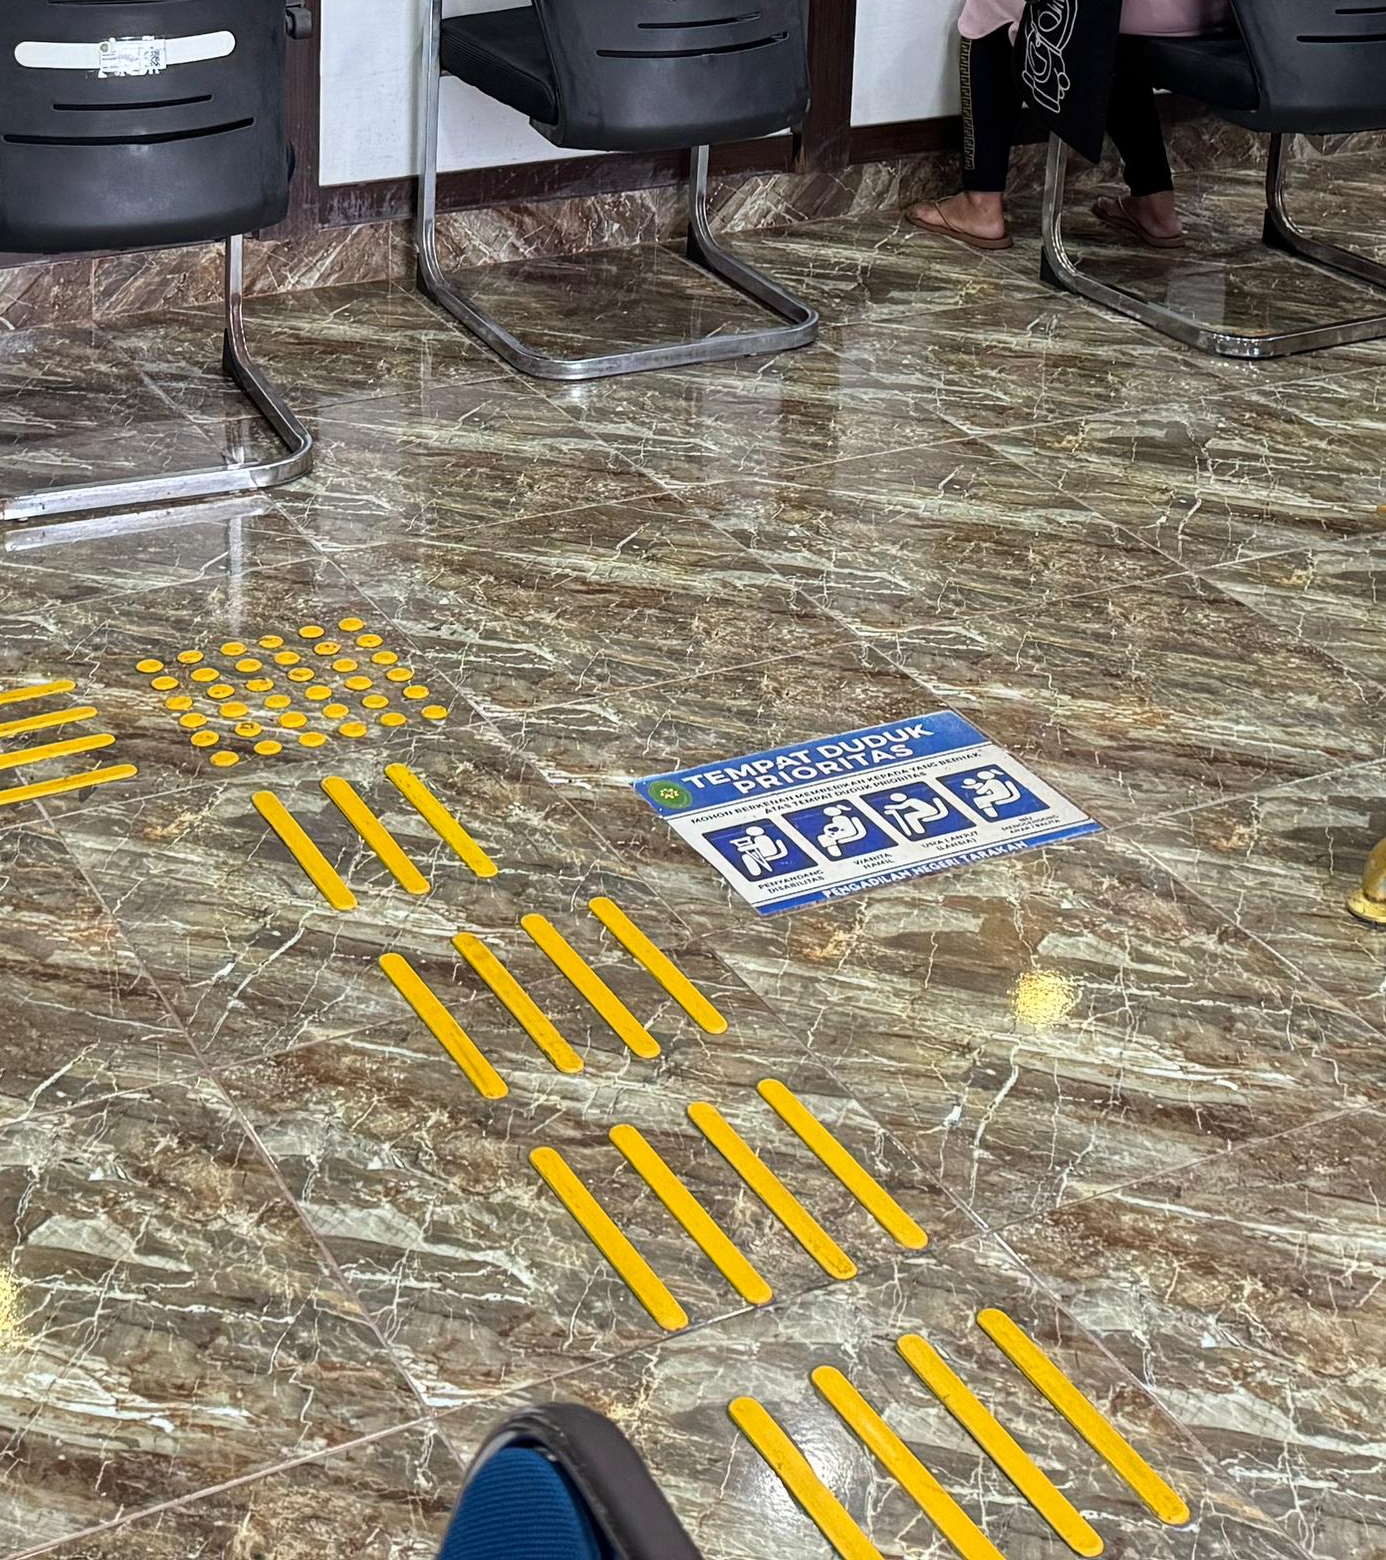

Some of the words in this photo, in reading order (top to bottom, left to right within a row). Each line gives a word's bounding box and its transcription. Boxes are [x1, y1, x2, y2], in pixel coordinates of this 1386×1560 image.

[682, 749, 813, 789] TEMPAT
[816, 723, 934, 759] DUDUK
[733, 744, 914, 794] PRIORITAS
[765, 803, 792, 815] ATAS
[793, 792, 834, 808] TEMPAT
[835, 784, 873, 798] DUDUK
[874, 772, 927, 788] PRIORITAS
[691, 810, 734, 825] MOHON
[822, 867, 912, 899] PENGADILAN
[913, 857, 961, 876] NEGERI
[960, 841, 1029, 864] TARAKAN
[854, 853, 893, 866] WANITA
[863, 859, 895, 870] HAMIL
[758, 869, 824, 890] PENYANDANG
[768, 876, 825, 894] DISABILITAS
